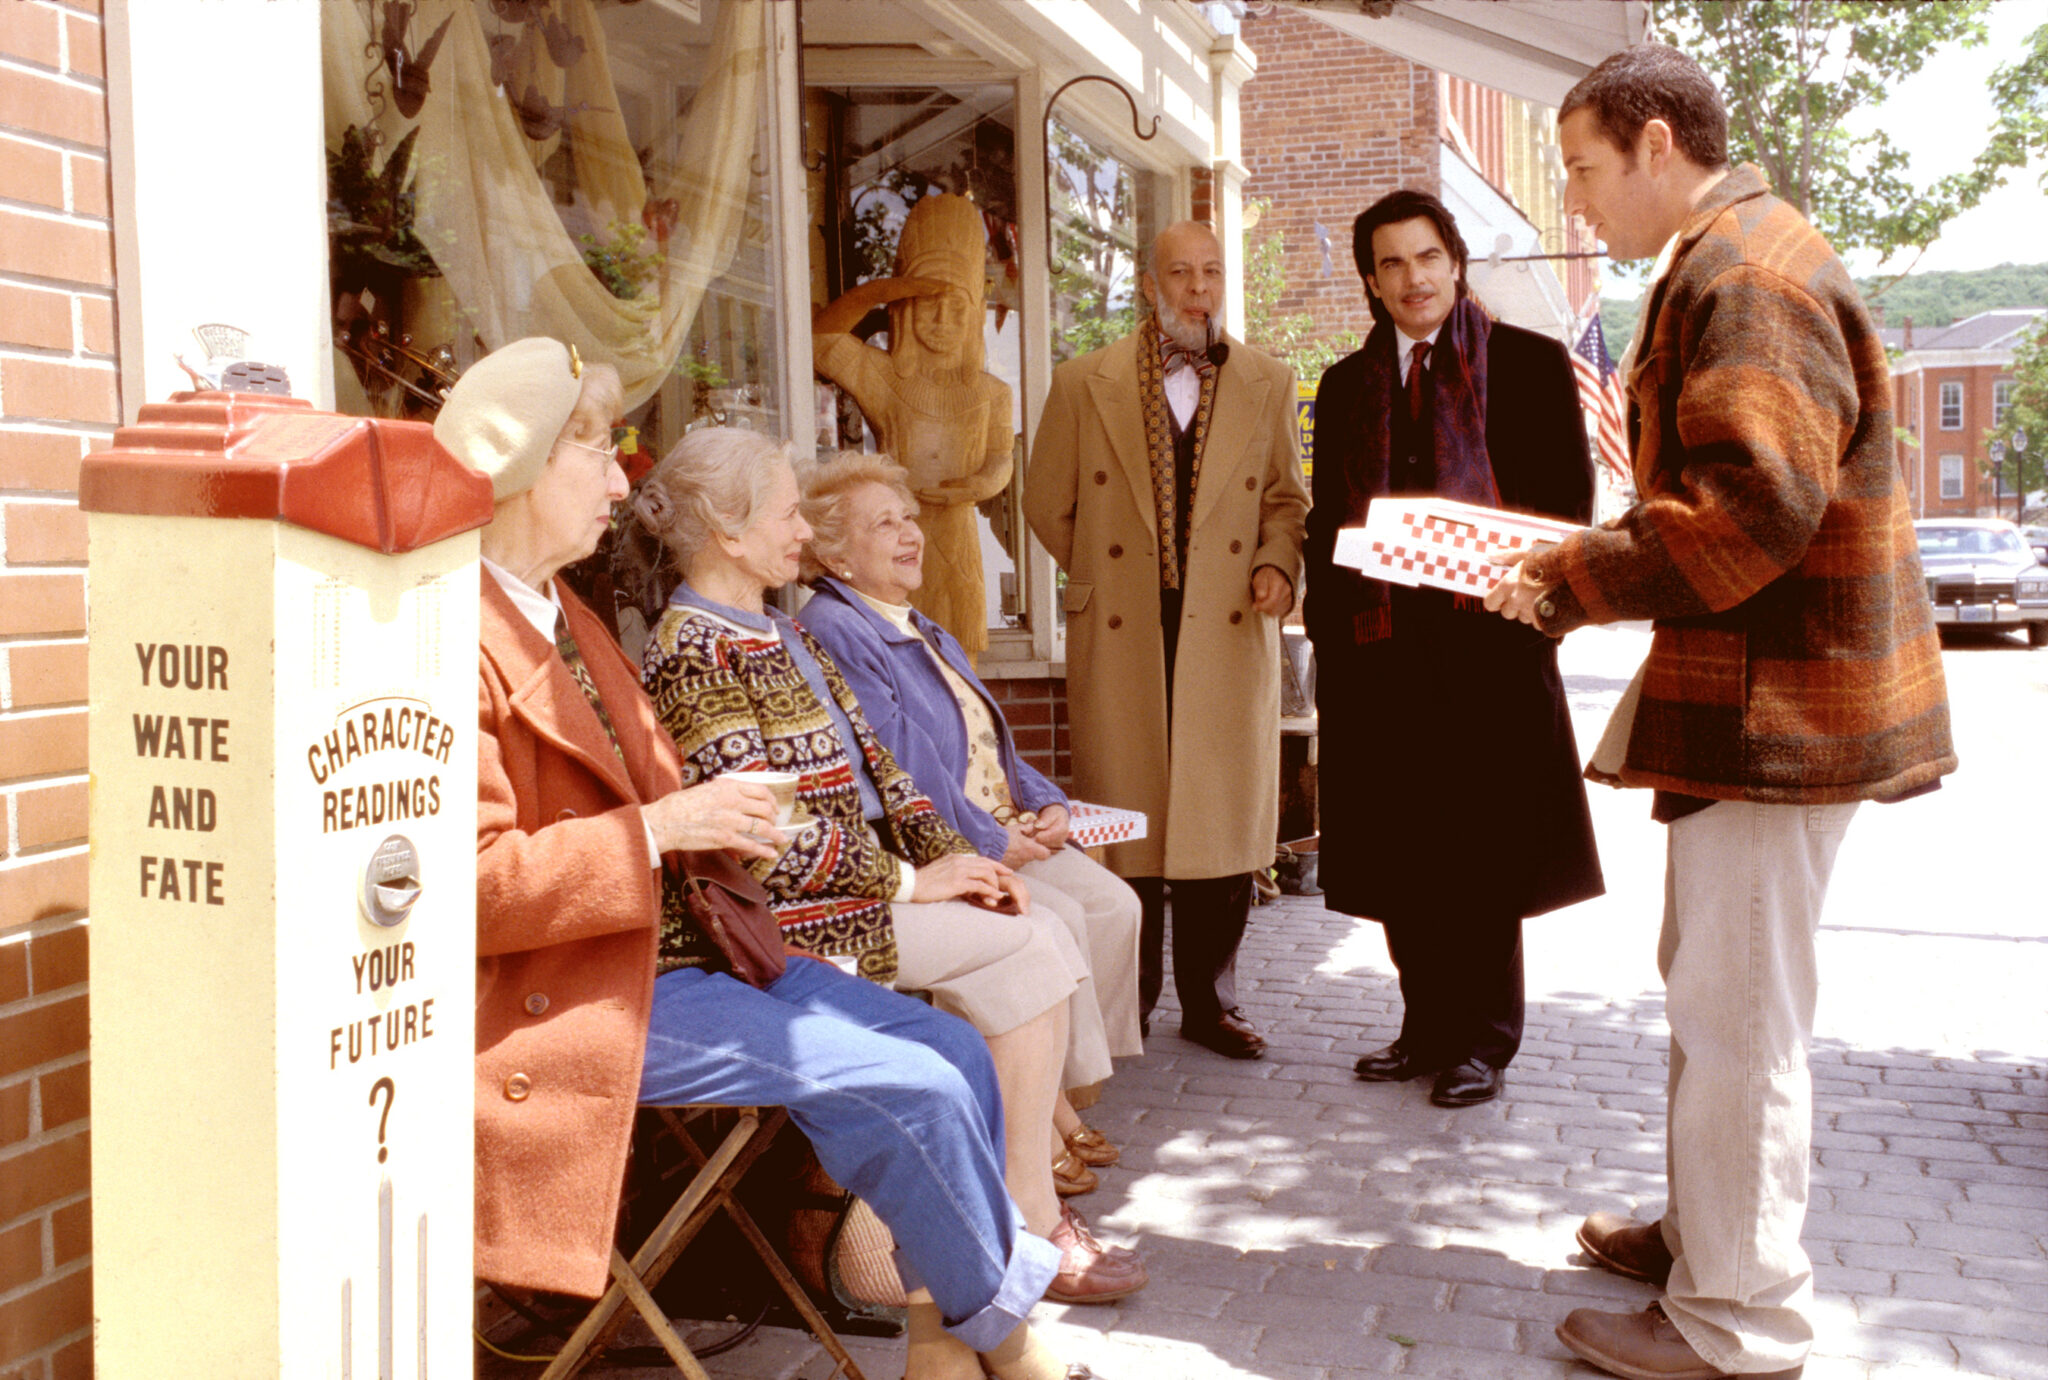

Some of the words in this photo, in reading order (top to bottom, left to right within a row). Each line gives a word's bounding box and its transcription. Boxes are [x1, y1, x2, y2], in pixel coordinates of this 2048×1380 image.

[136, 643, 228, 690] YOUR
[133, 714, 229, 762] WATE
[308, 707, 454, 785] CHARACTER
[149, 786, 216, 832] AND
[324, 776, 439, 833] READINGS
[141, 856, 224, 905] FATE
[353, 942, 414, 994] YOUR
[331, 999, 433, 1069] FUTURE
[369, 1077, 394, 1163] ?
